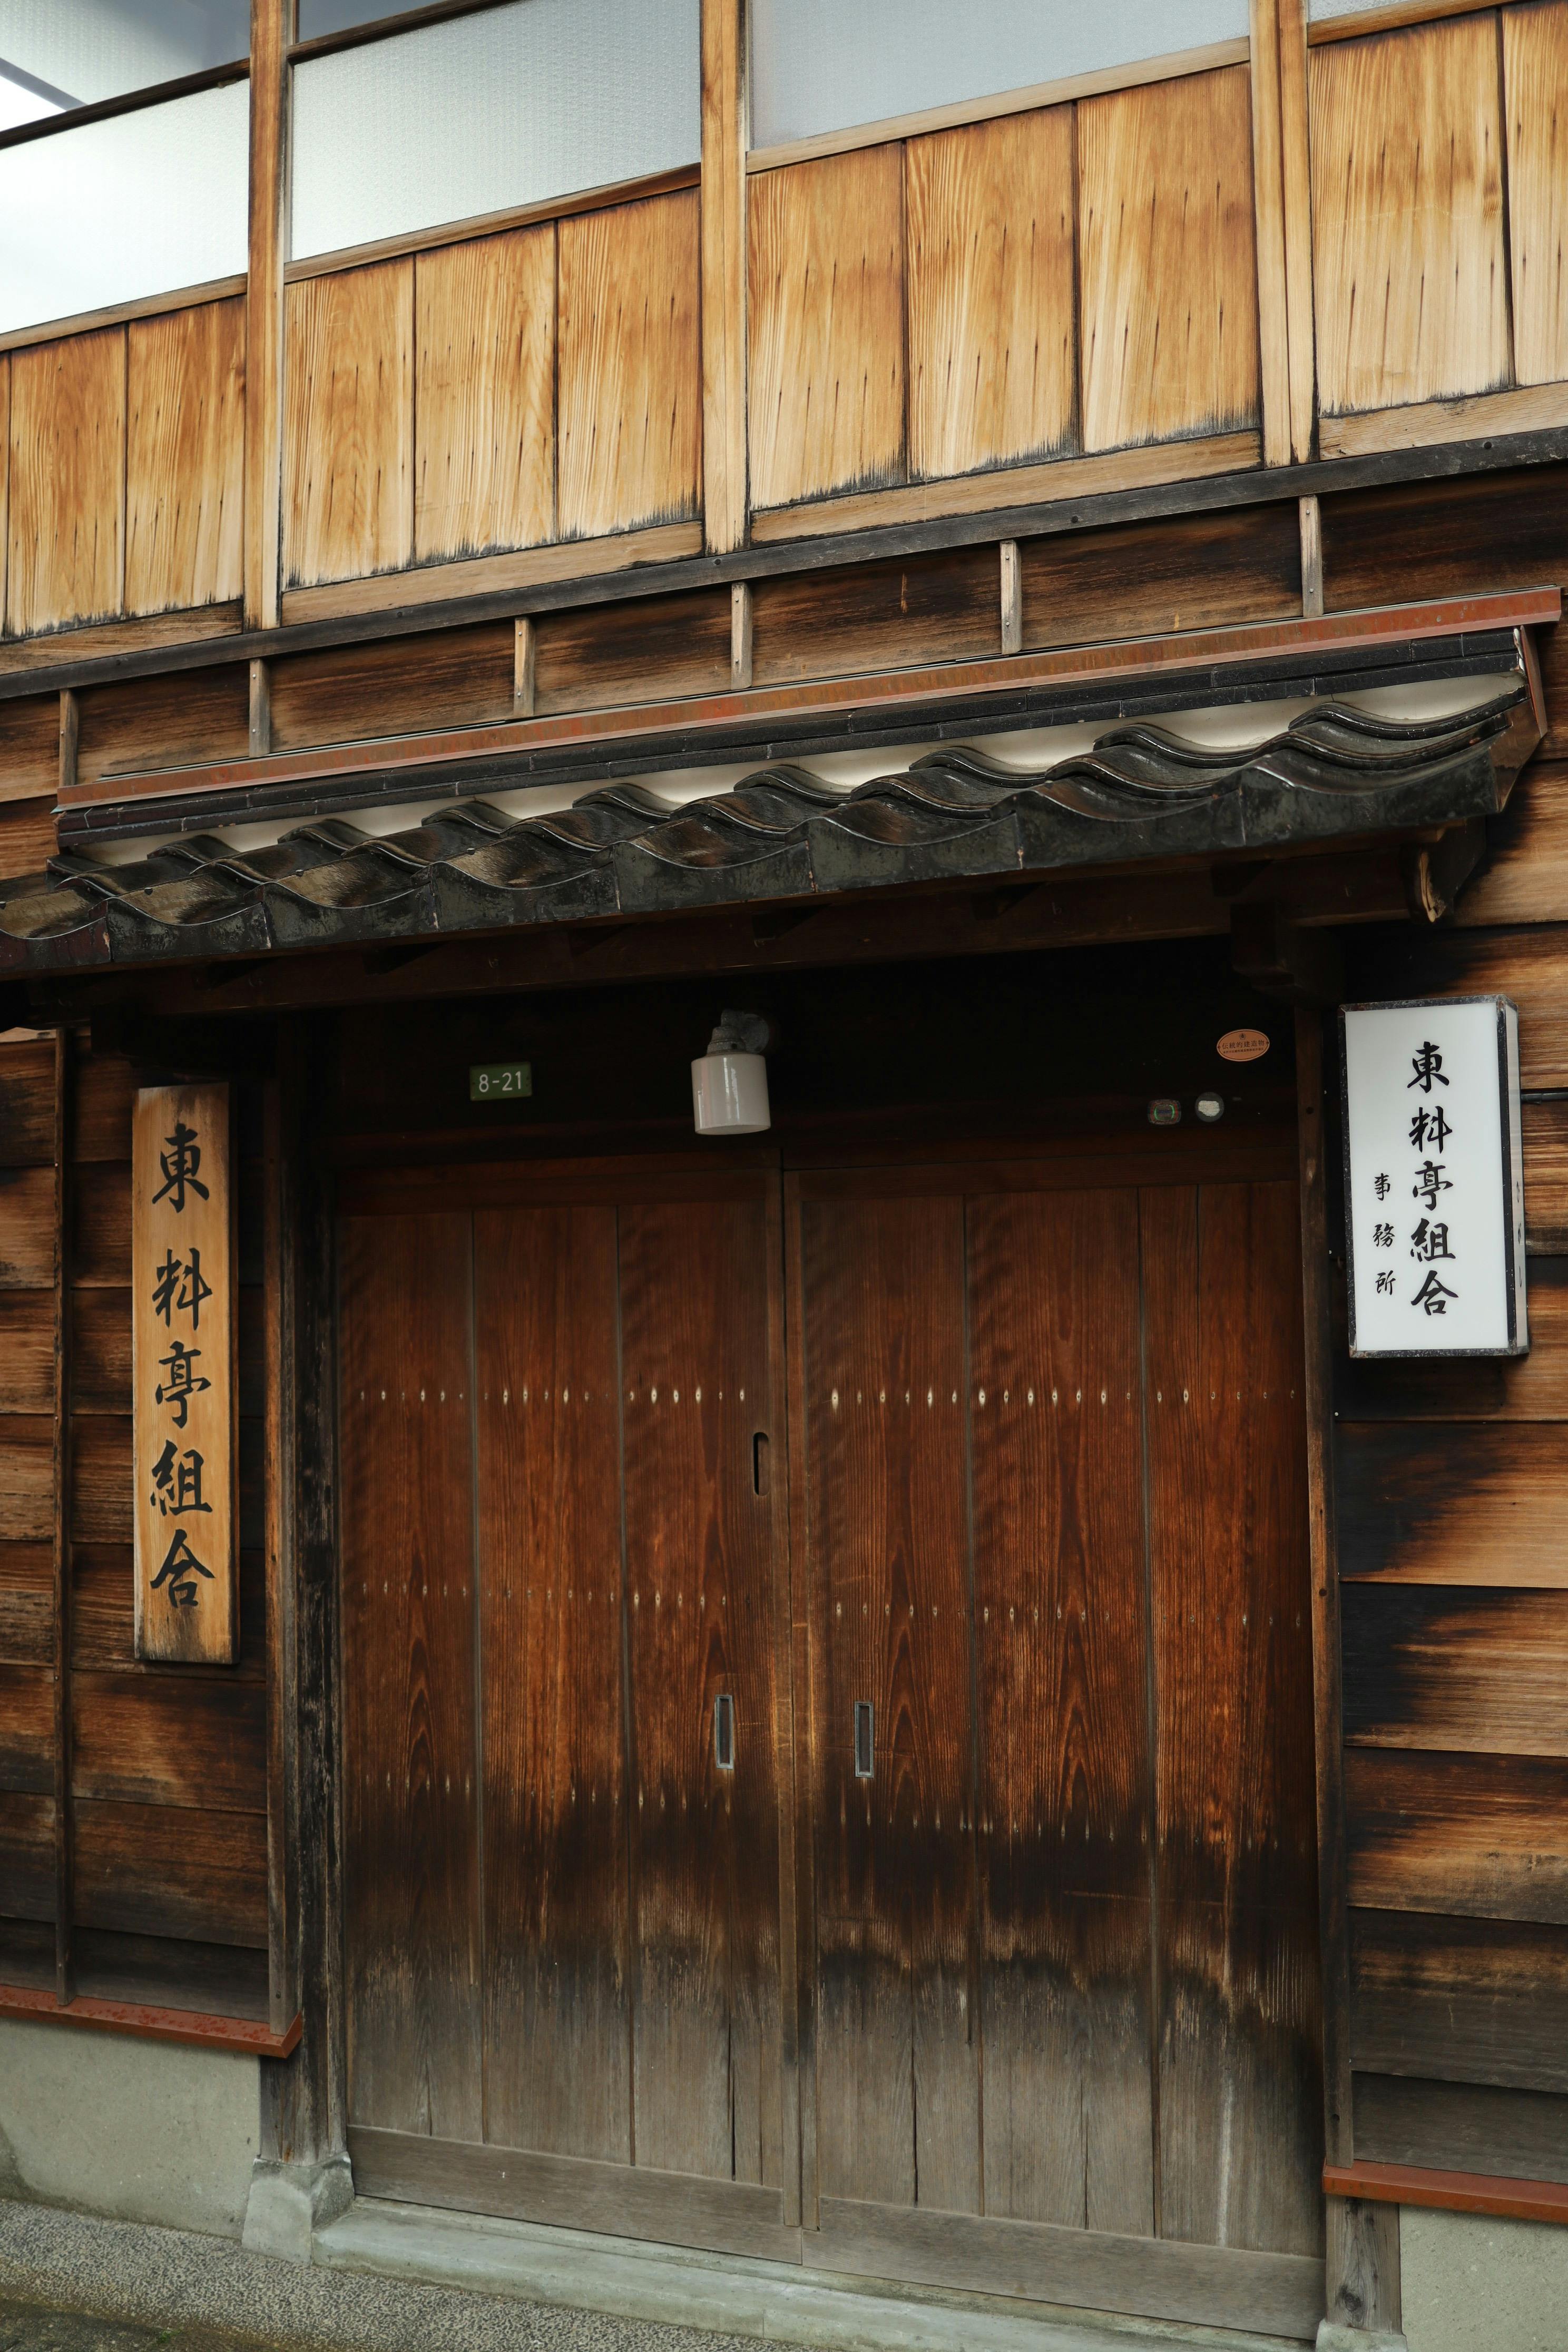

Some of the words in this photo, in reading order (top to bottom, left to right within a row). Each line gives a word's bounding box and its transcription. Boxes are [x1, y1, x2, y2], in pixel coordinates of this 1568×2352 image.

[479, 1071, 522, 1093] 8-21
[1222, 1040, 1265, 1050] 伝統的建造物
[1373, 1173, 1397, 1296] 事務所
[1407, 1041, 1459, 1317] 東料亭組合
[150, 1123, 215, 1608] 東料亭組合
